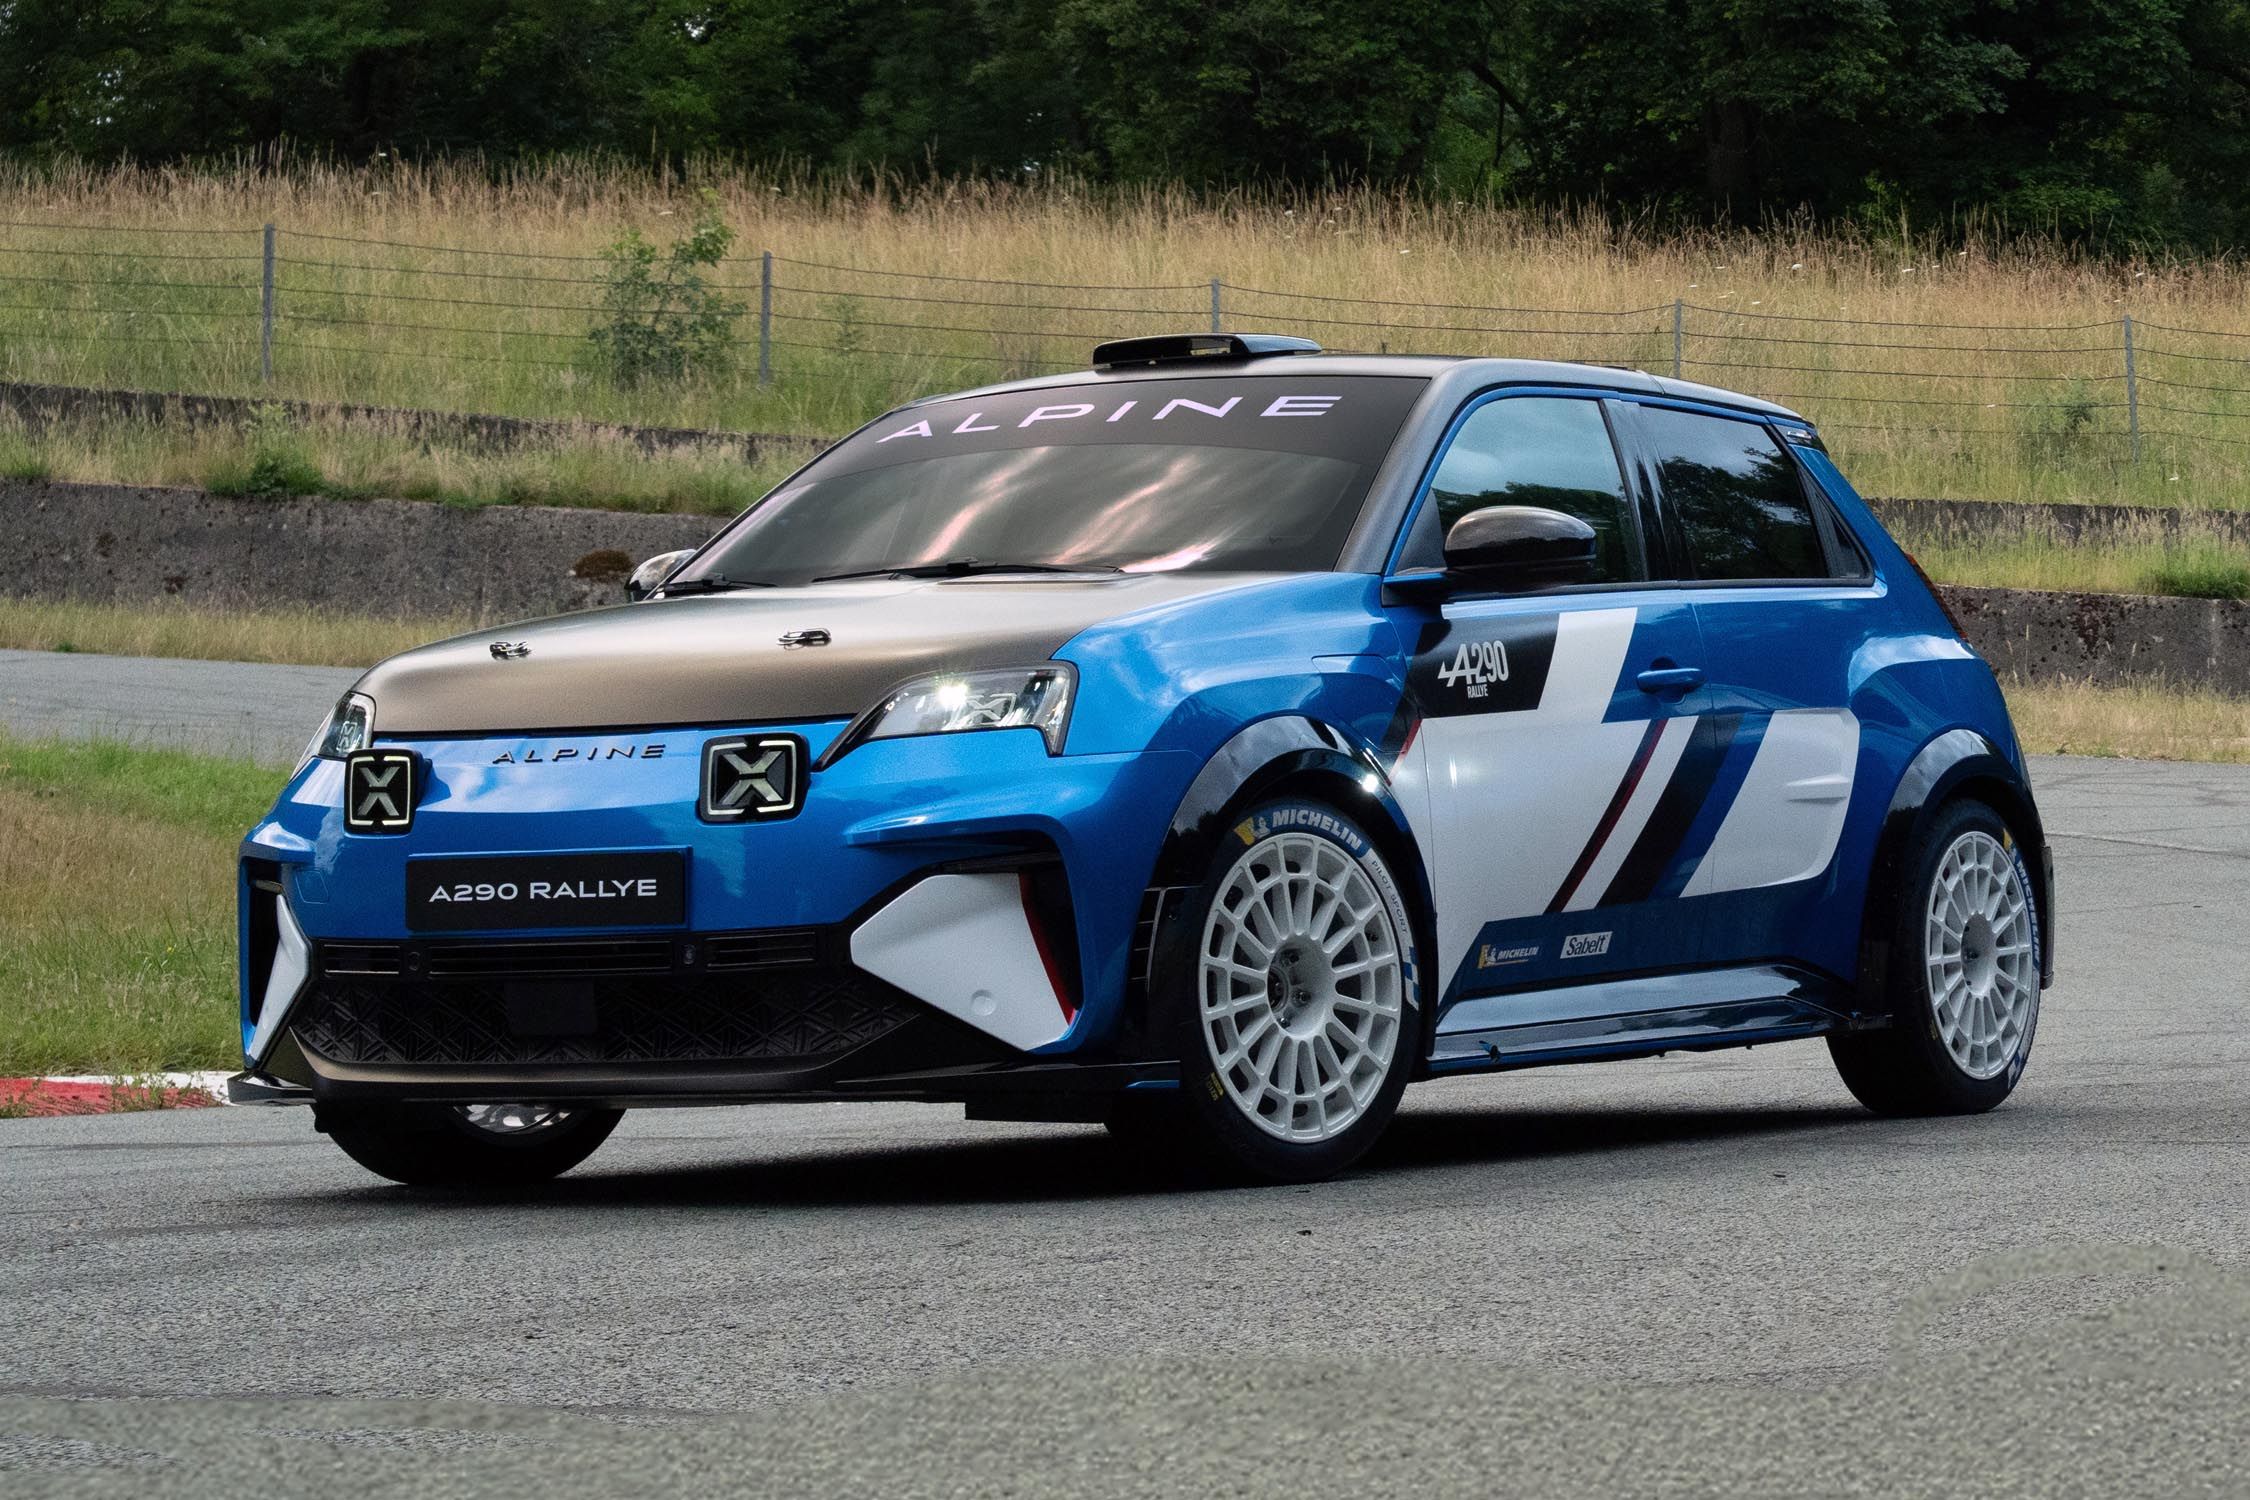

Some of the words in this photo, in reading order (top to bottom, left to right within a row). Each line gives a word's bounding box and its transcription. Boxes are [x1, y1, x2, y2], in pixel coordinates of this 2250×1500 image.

[876, 395, 1343, 444] ALPINE
[1438, 640, 1509, 687] A290
[1467, 683, 1489, 699] RALLYE
[492, 744, 667, 764] ALPINE
[1272, 809, 1363, 851] MICHELIN
[429, 883, 519, 903] A290
[529, 879, 657, 899] RALLYE
[1372, 860, 1392, 890] PILOT
[1390, 894, 1408, 935] SPORT
[1497, 946, 1540, 961] MICHELIN
[1566, 935, 1608, 956] Sabelt
